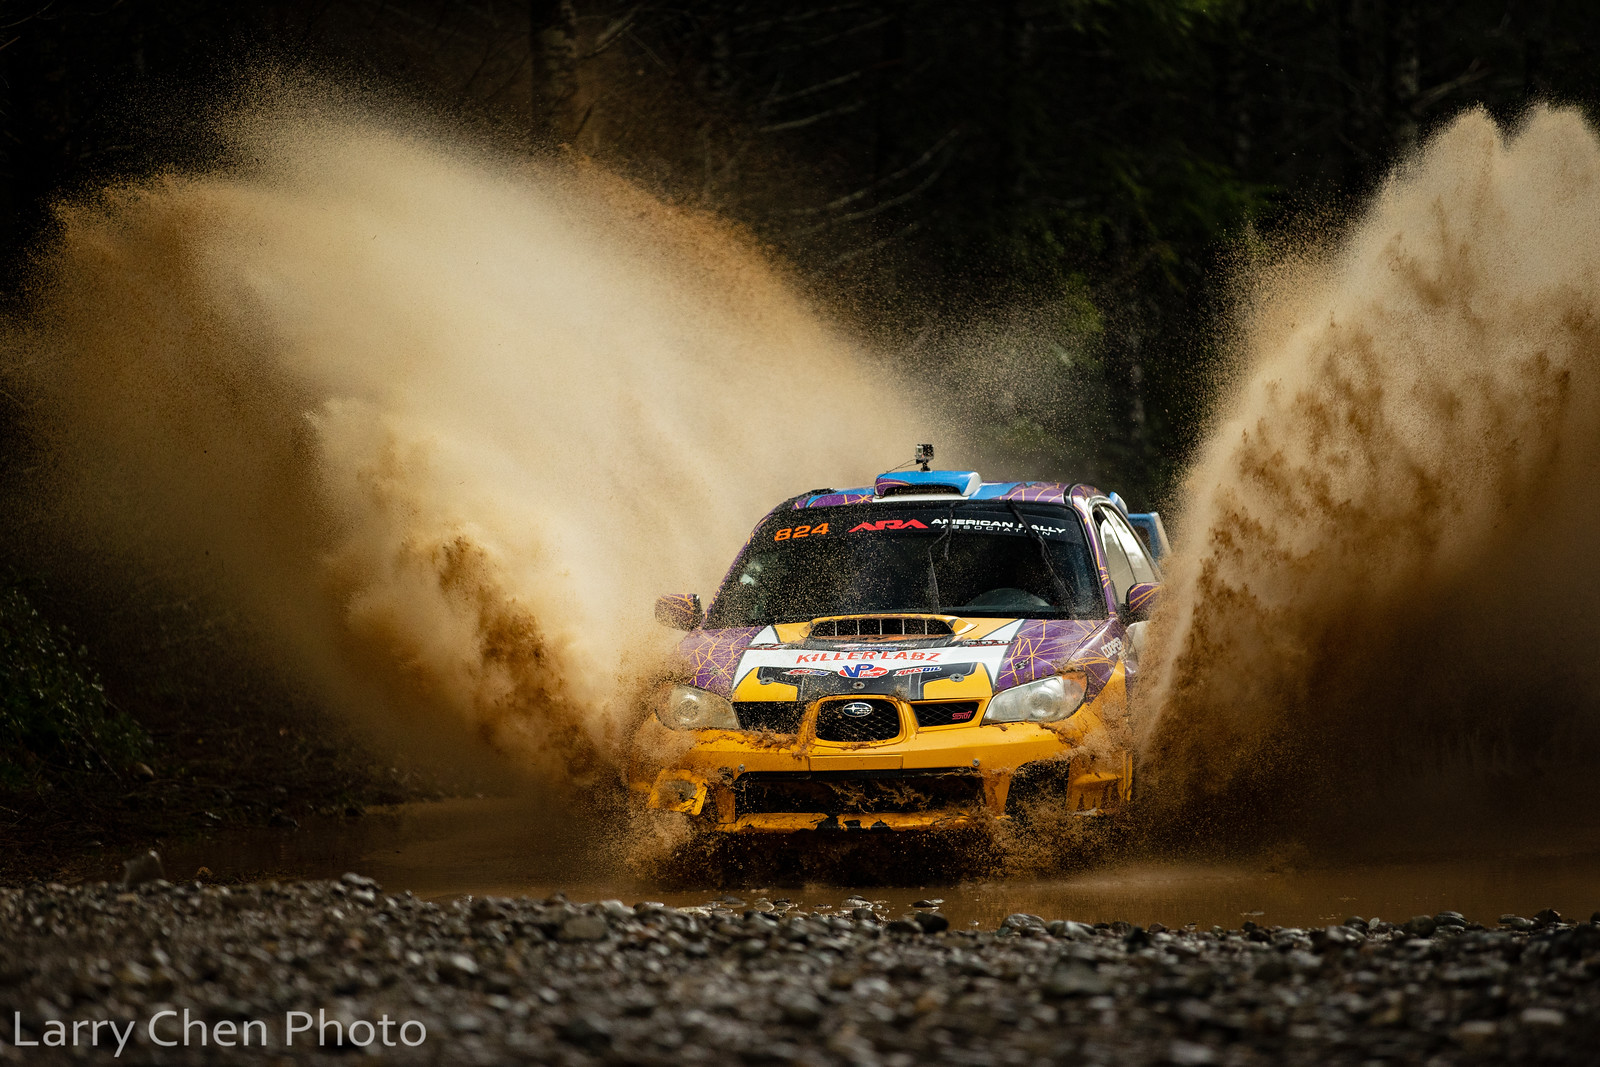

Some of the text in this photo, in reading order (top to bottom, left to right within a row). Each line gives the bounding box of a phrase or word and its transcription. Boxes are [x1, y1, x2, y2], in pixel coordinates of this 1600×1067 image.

[848, 518, 929, 534] ARA
[931, 517, 1014, 529] AMERICAN
[773, 522, 830, 542] 824
[842, 663, 875, 678] VP
[893, 666, 943, 677] AMSOIL
